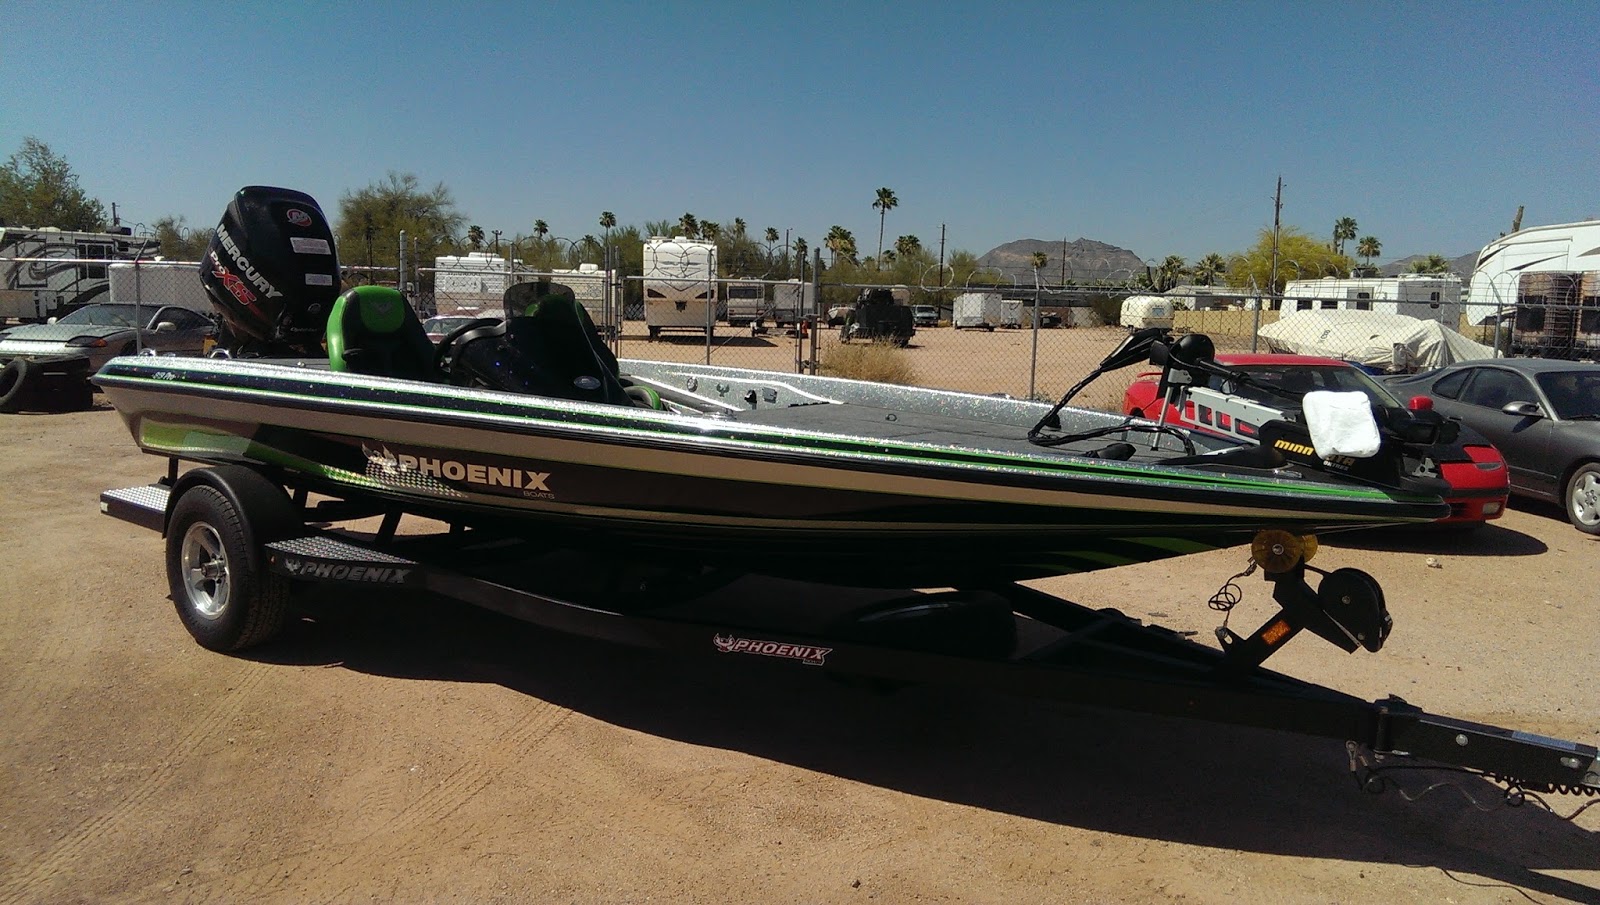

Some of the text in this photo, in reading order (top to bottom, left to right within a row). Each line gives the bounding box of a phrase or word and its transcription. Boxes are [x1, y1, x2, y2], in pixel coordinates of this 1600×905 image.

[216, 223, 284, 299] MERCURY
[398, 453, 551, 492] PHOENIX
[299, 560, 412, 584] PHOENIX
[734, 640, 826, 660] PHOENIX
